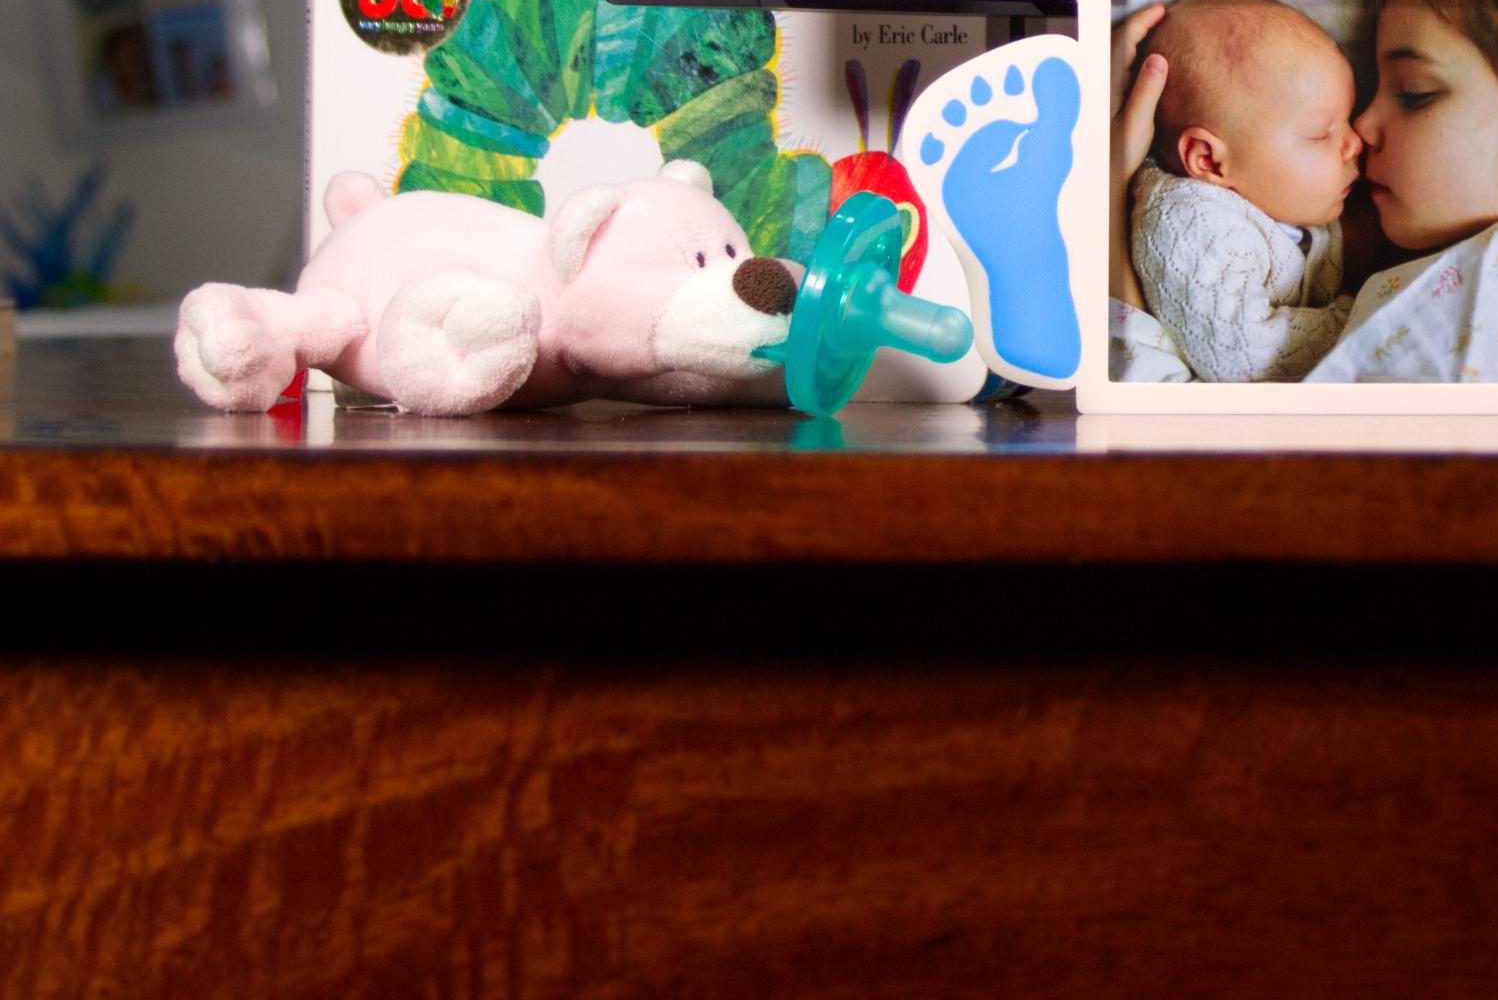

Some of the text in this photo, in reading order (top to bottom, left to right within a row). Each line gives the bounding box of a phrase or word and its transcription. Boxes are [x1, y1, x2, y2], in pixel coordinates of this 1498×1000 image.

[852, 24, 968, 50] by Eric Carle
